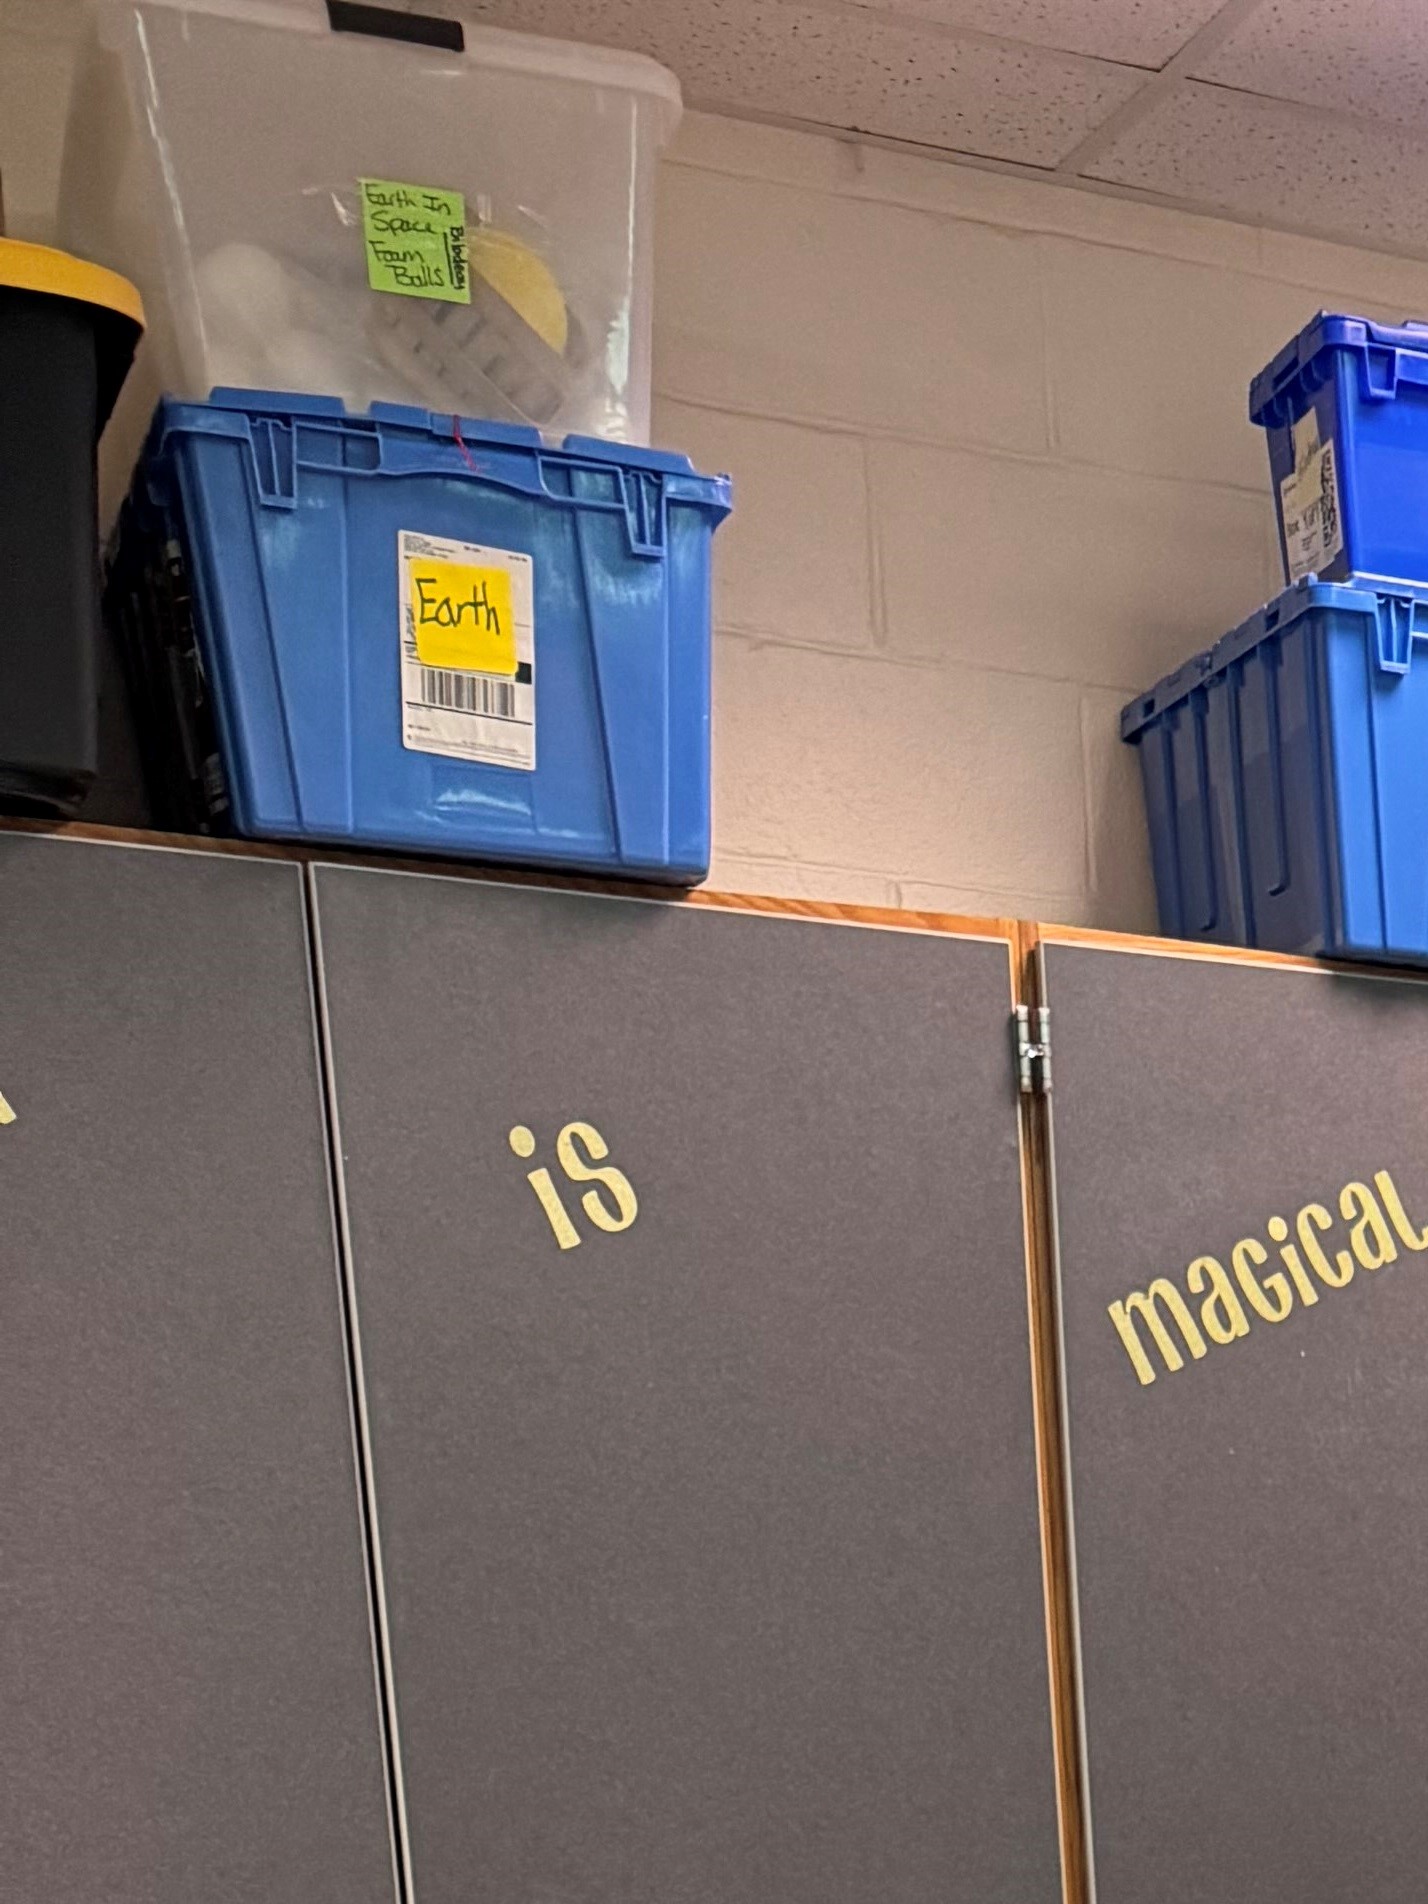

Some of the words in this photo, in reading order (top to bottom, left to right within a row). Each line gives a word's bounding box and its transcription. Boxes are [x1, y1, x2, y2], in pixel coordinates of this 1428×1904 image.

[365, 183, 416, 208] Earth
[370, 210, 438, 236] Space
[368, 240, 424, 263] Foam
[385, 264, 444, 287] Balls
[415, 578, 500, 635] Earth
[509, 1121, 638, 1249] is
